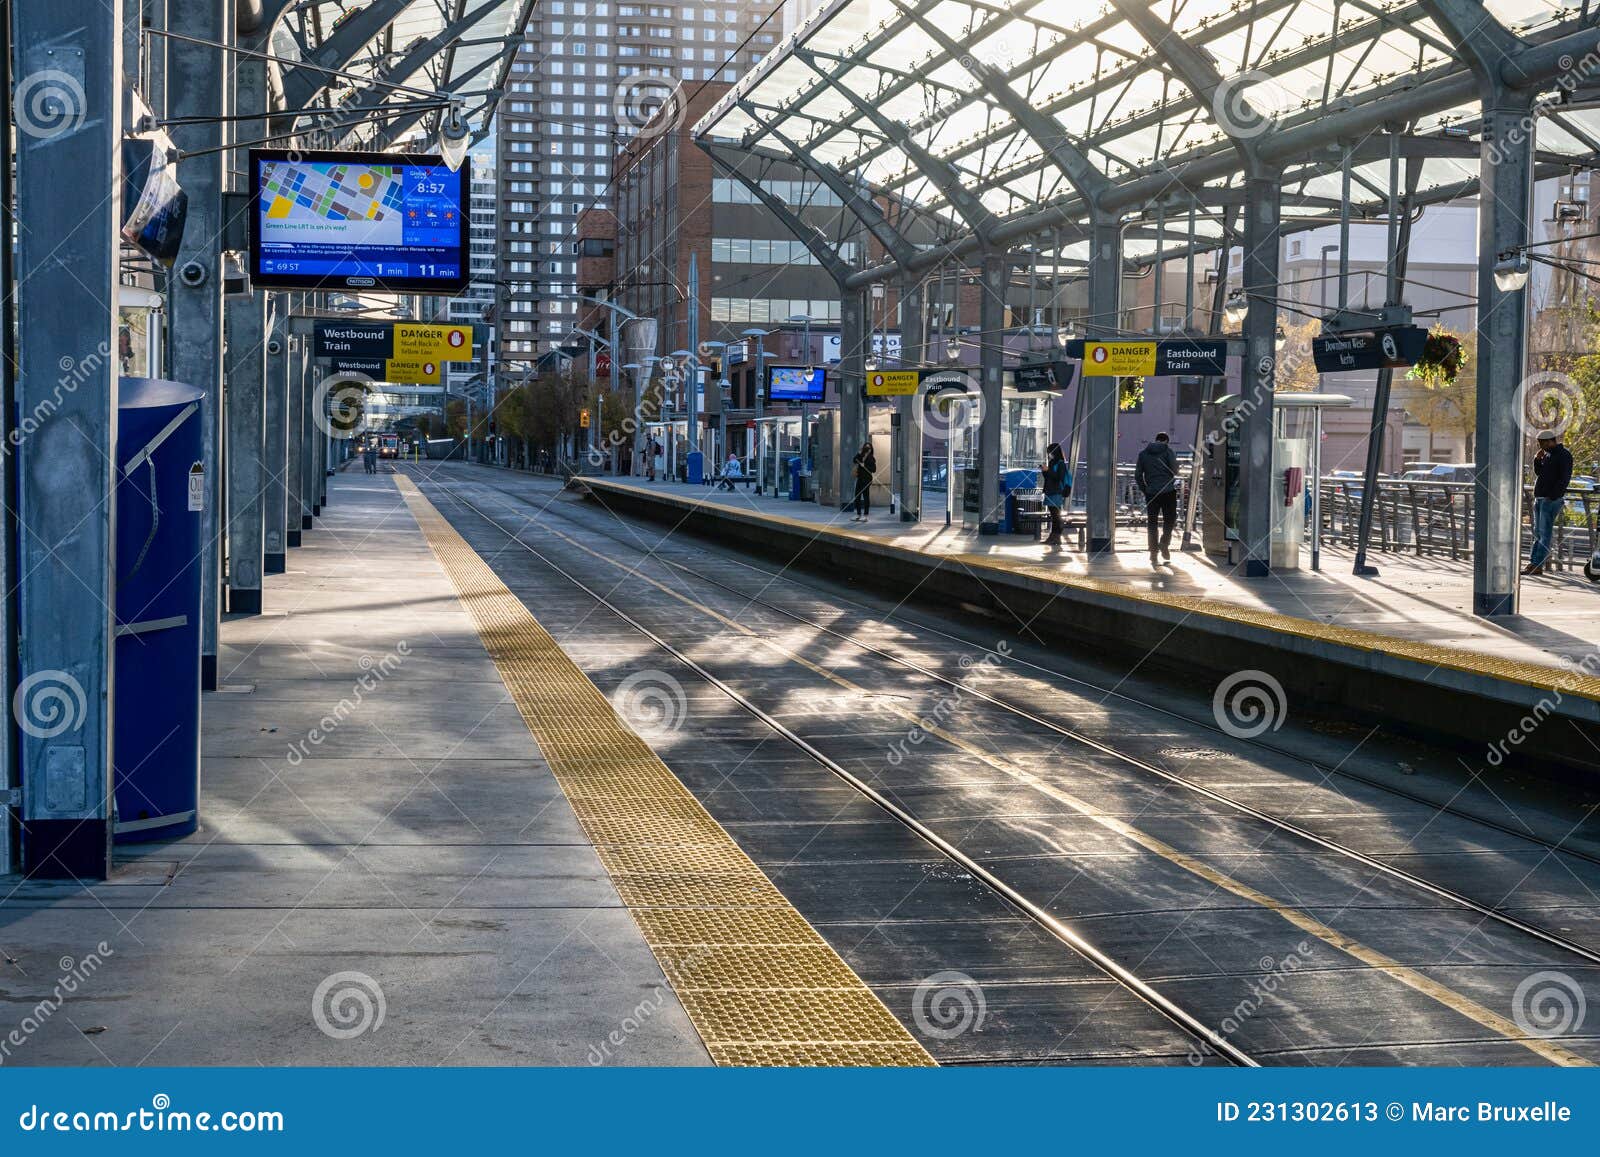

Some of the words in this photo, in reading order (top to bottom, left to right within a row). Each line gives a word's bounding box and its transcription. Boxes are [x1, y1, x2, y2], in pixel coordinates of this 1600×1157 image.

[417, 183, 445, 194] 8:57
[265, 222, 283, 230] Green
[277, 263, 288, 271] 69
[289, 263, 299, 271] ST
[376, 263, 383, 275] 1
[387, 267, 403, 275] min
[419, 264, 435, 276] 11
[439, 268, 455, 276] min
[323, 328, 385, 340] Westbound
[400, 329, 443, 339] DANGER
[323, 341, 351, 350] Train
[1111, 346, 1150, 356] DANGER
[1166, 348, 1217, 358] Eastbound
[338, 361, 381, 370] Westbound
[1166, 360, 1190, 369] Train
[338, 369, 357, 377] Train
[925, 375, 961, 383] Eastbound
